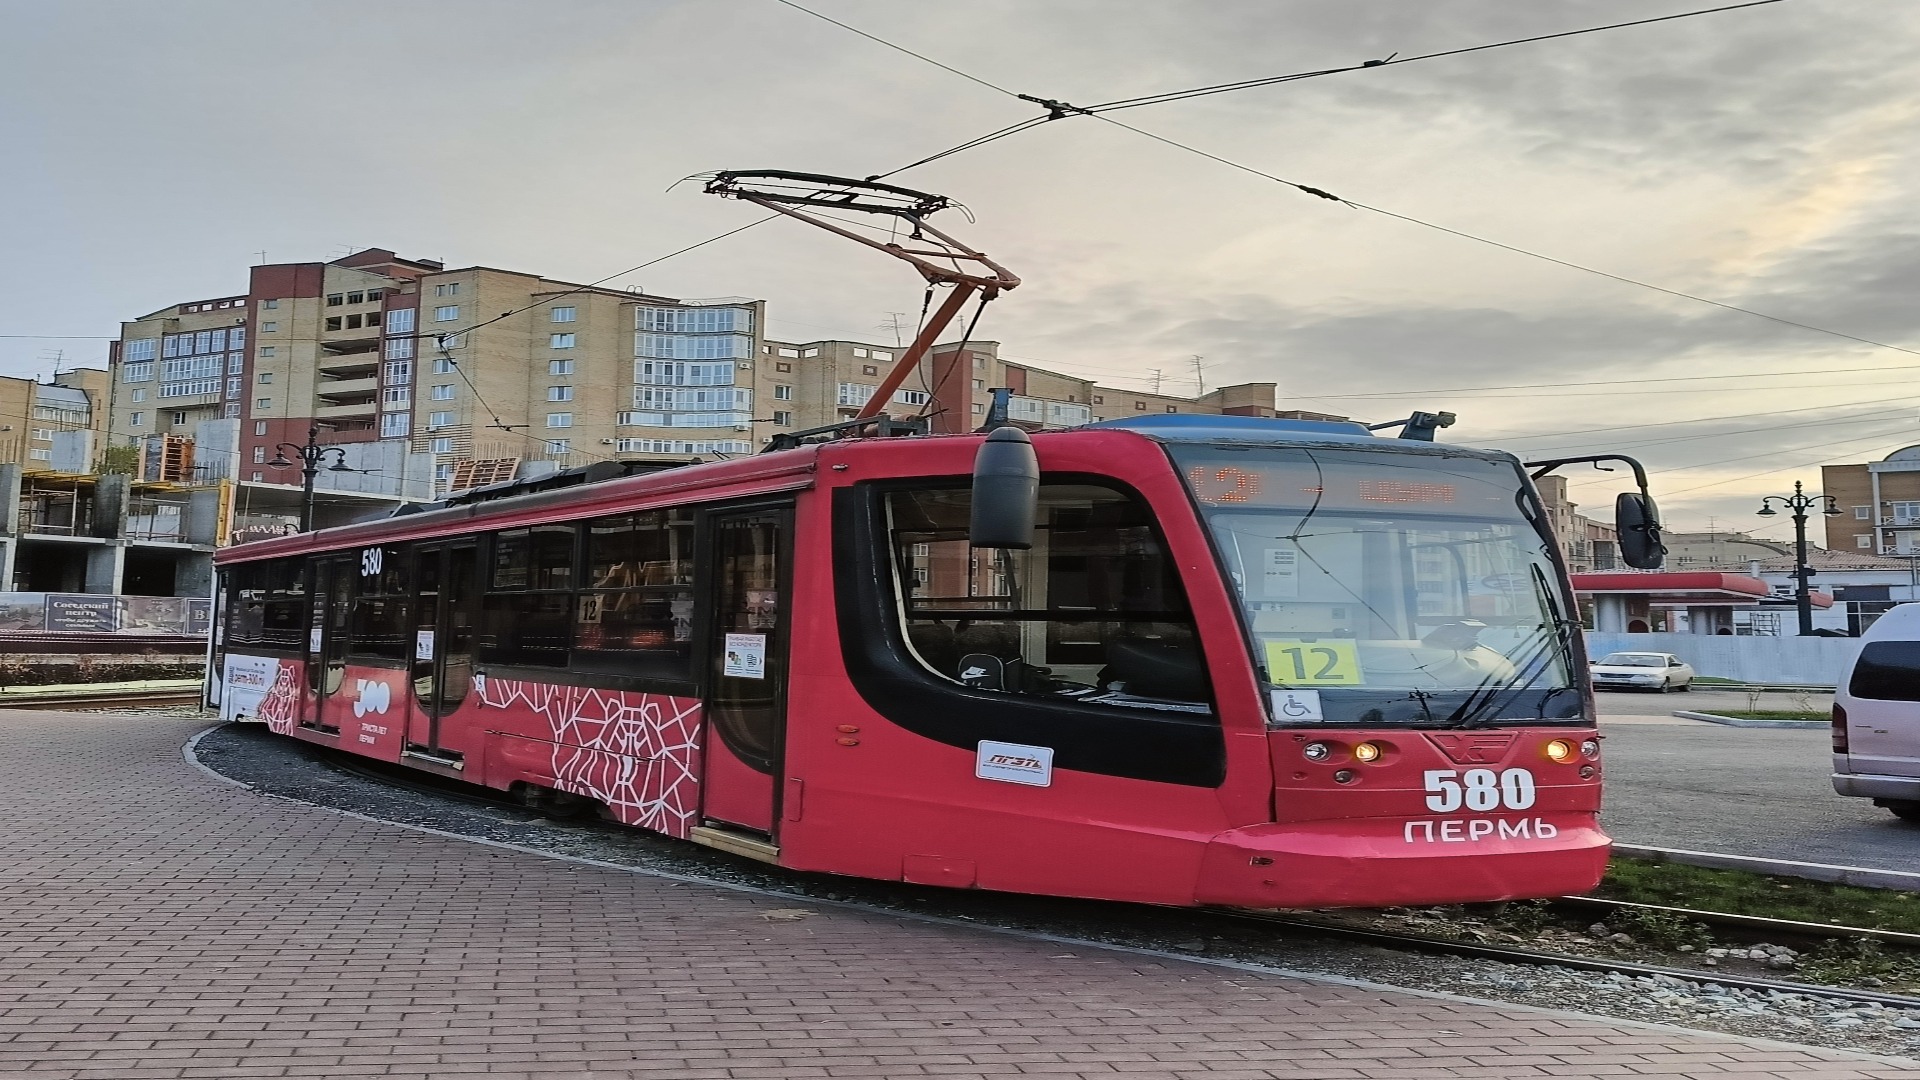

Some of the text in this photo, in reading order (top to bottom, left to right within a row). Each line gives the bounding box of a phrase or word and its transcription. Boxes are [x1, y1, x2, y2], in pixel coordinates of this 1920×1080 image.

[361, 547, 382, 577] 580
[583, 600, 597, 620] 12
[1281, 647, 1344, 680] 12
[354, 679, 390, 718] 300
[1424, 768, 1536, 813] 580
[1404, 817, 1558, 843] ПЕРМЬ
